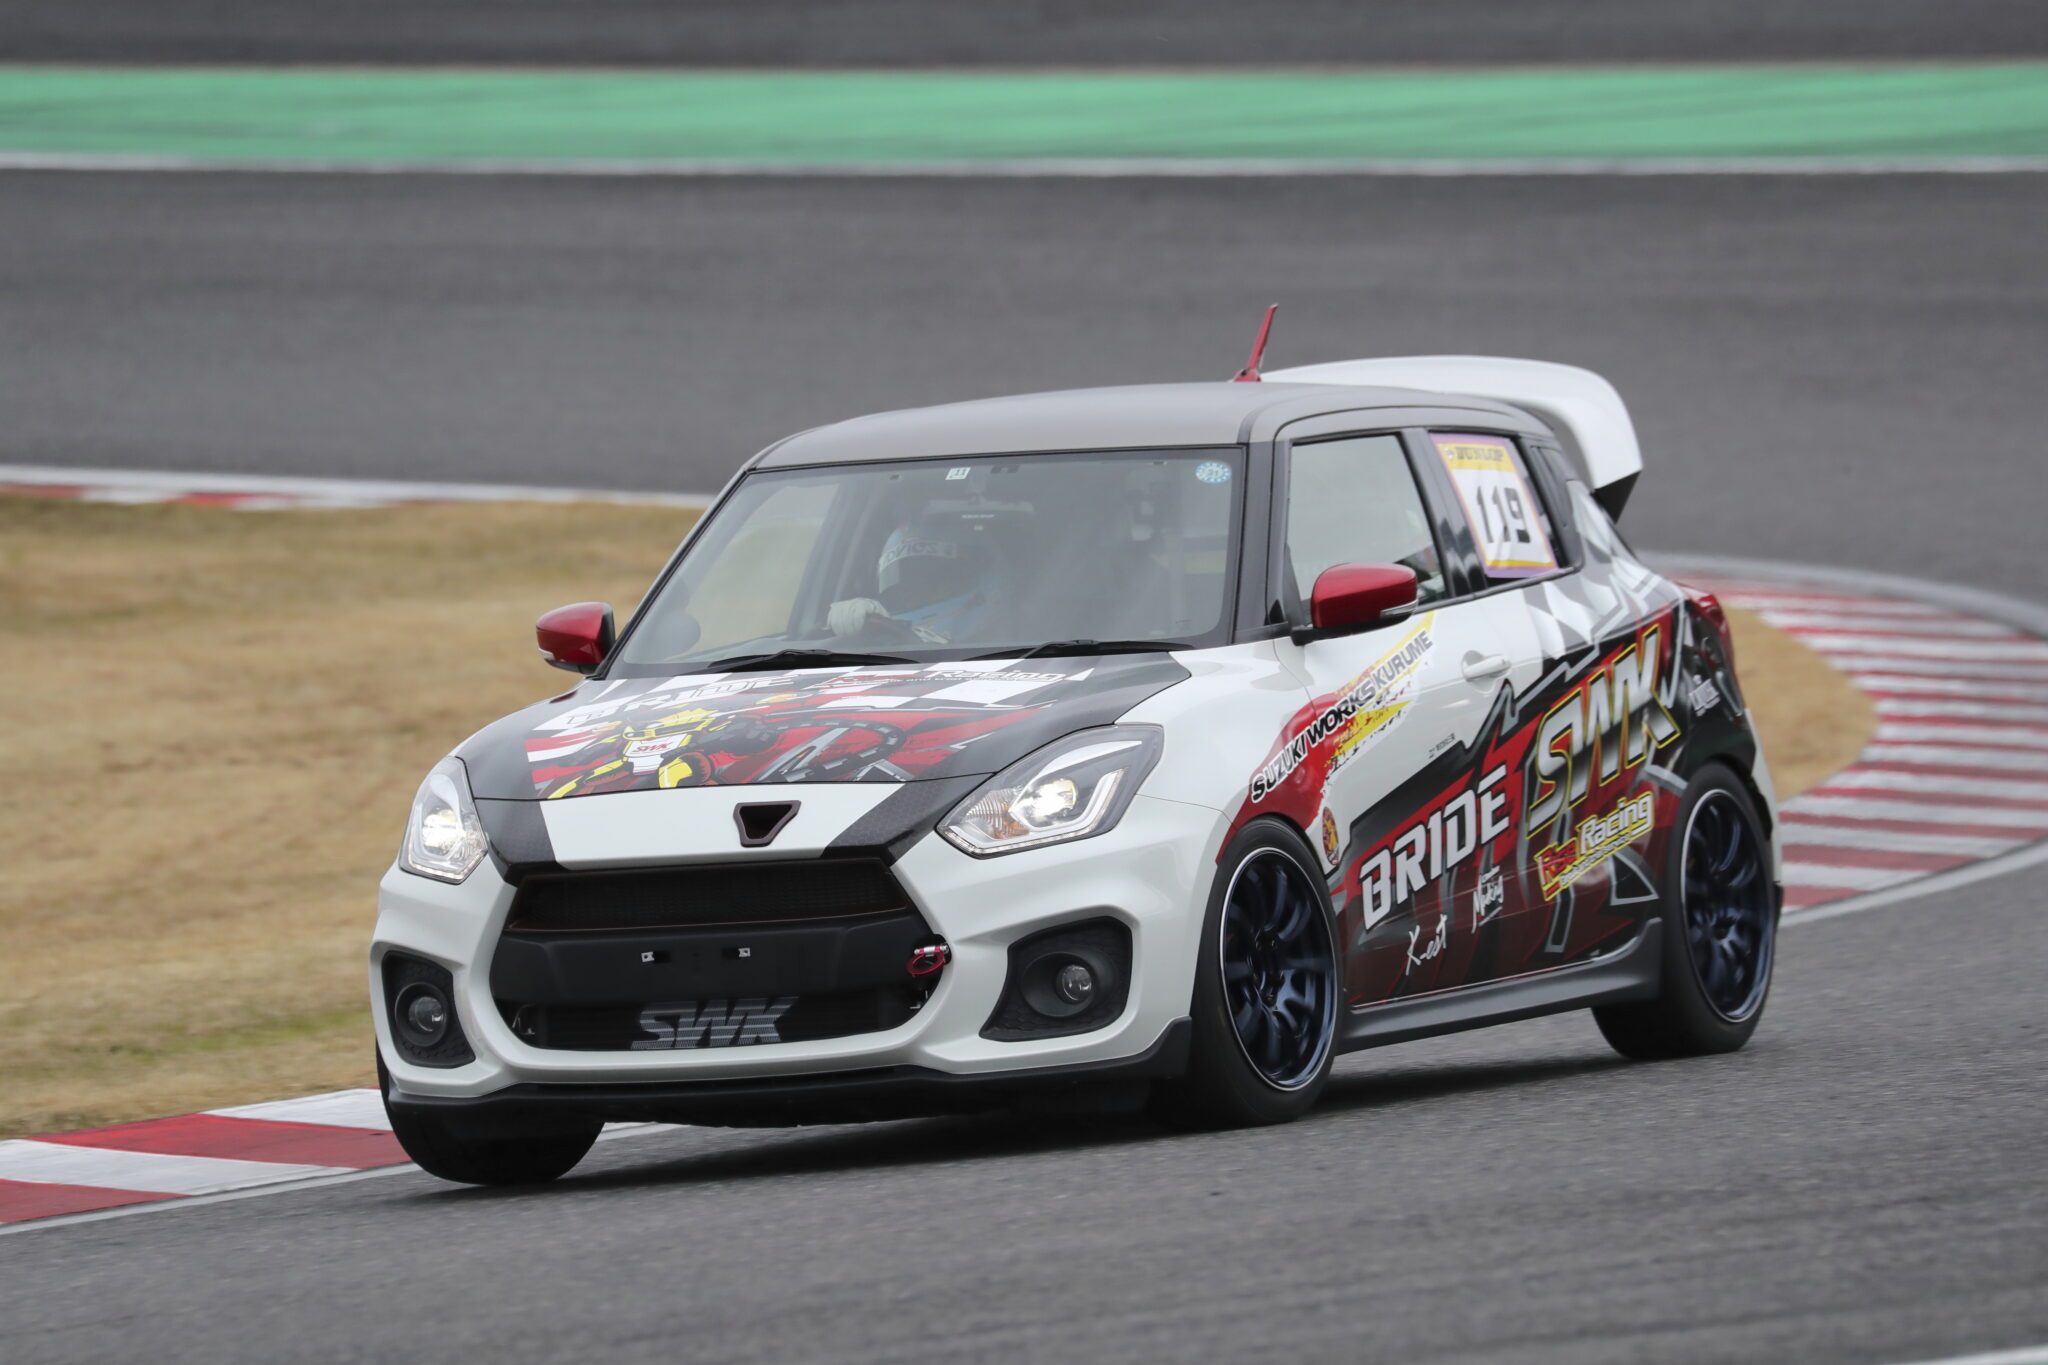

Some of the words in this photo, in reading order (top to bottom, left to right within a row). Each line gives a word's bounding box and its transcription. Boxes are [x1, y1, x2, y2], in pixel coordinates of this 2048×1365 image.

[1475, 485, 1531, 544] 119
[1252, 733, 1309, 802] SUZUKI
[1305, 681, 1377, 747] WORKS
[1371, 630, 1433, 690] KURUME
[1359, 764, 1510, 931] BRIDE
[1579, 793, 1654, 855] Racing
[630, 996, 800, 1050] SWK
